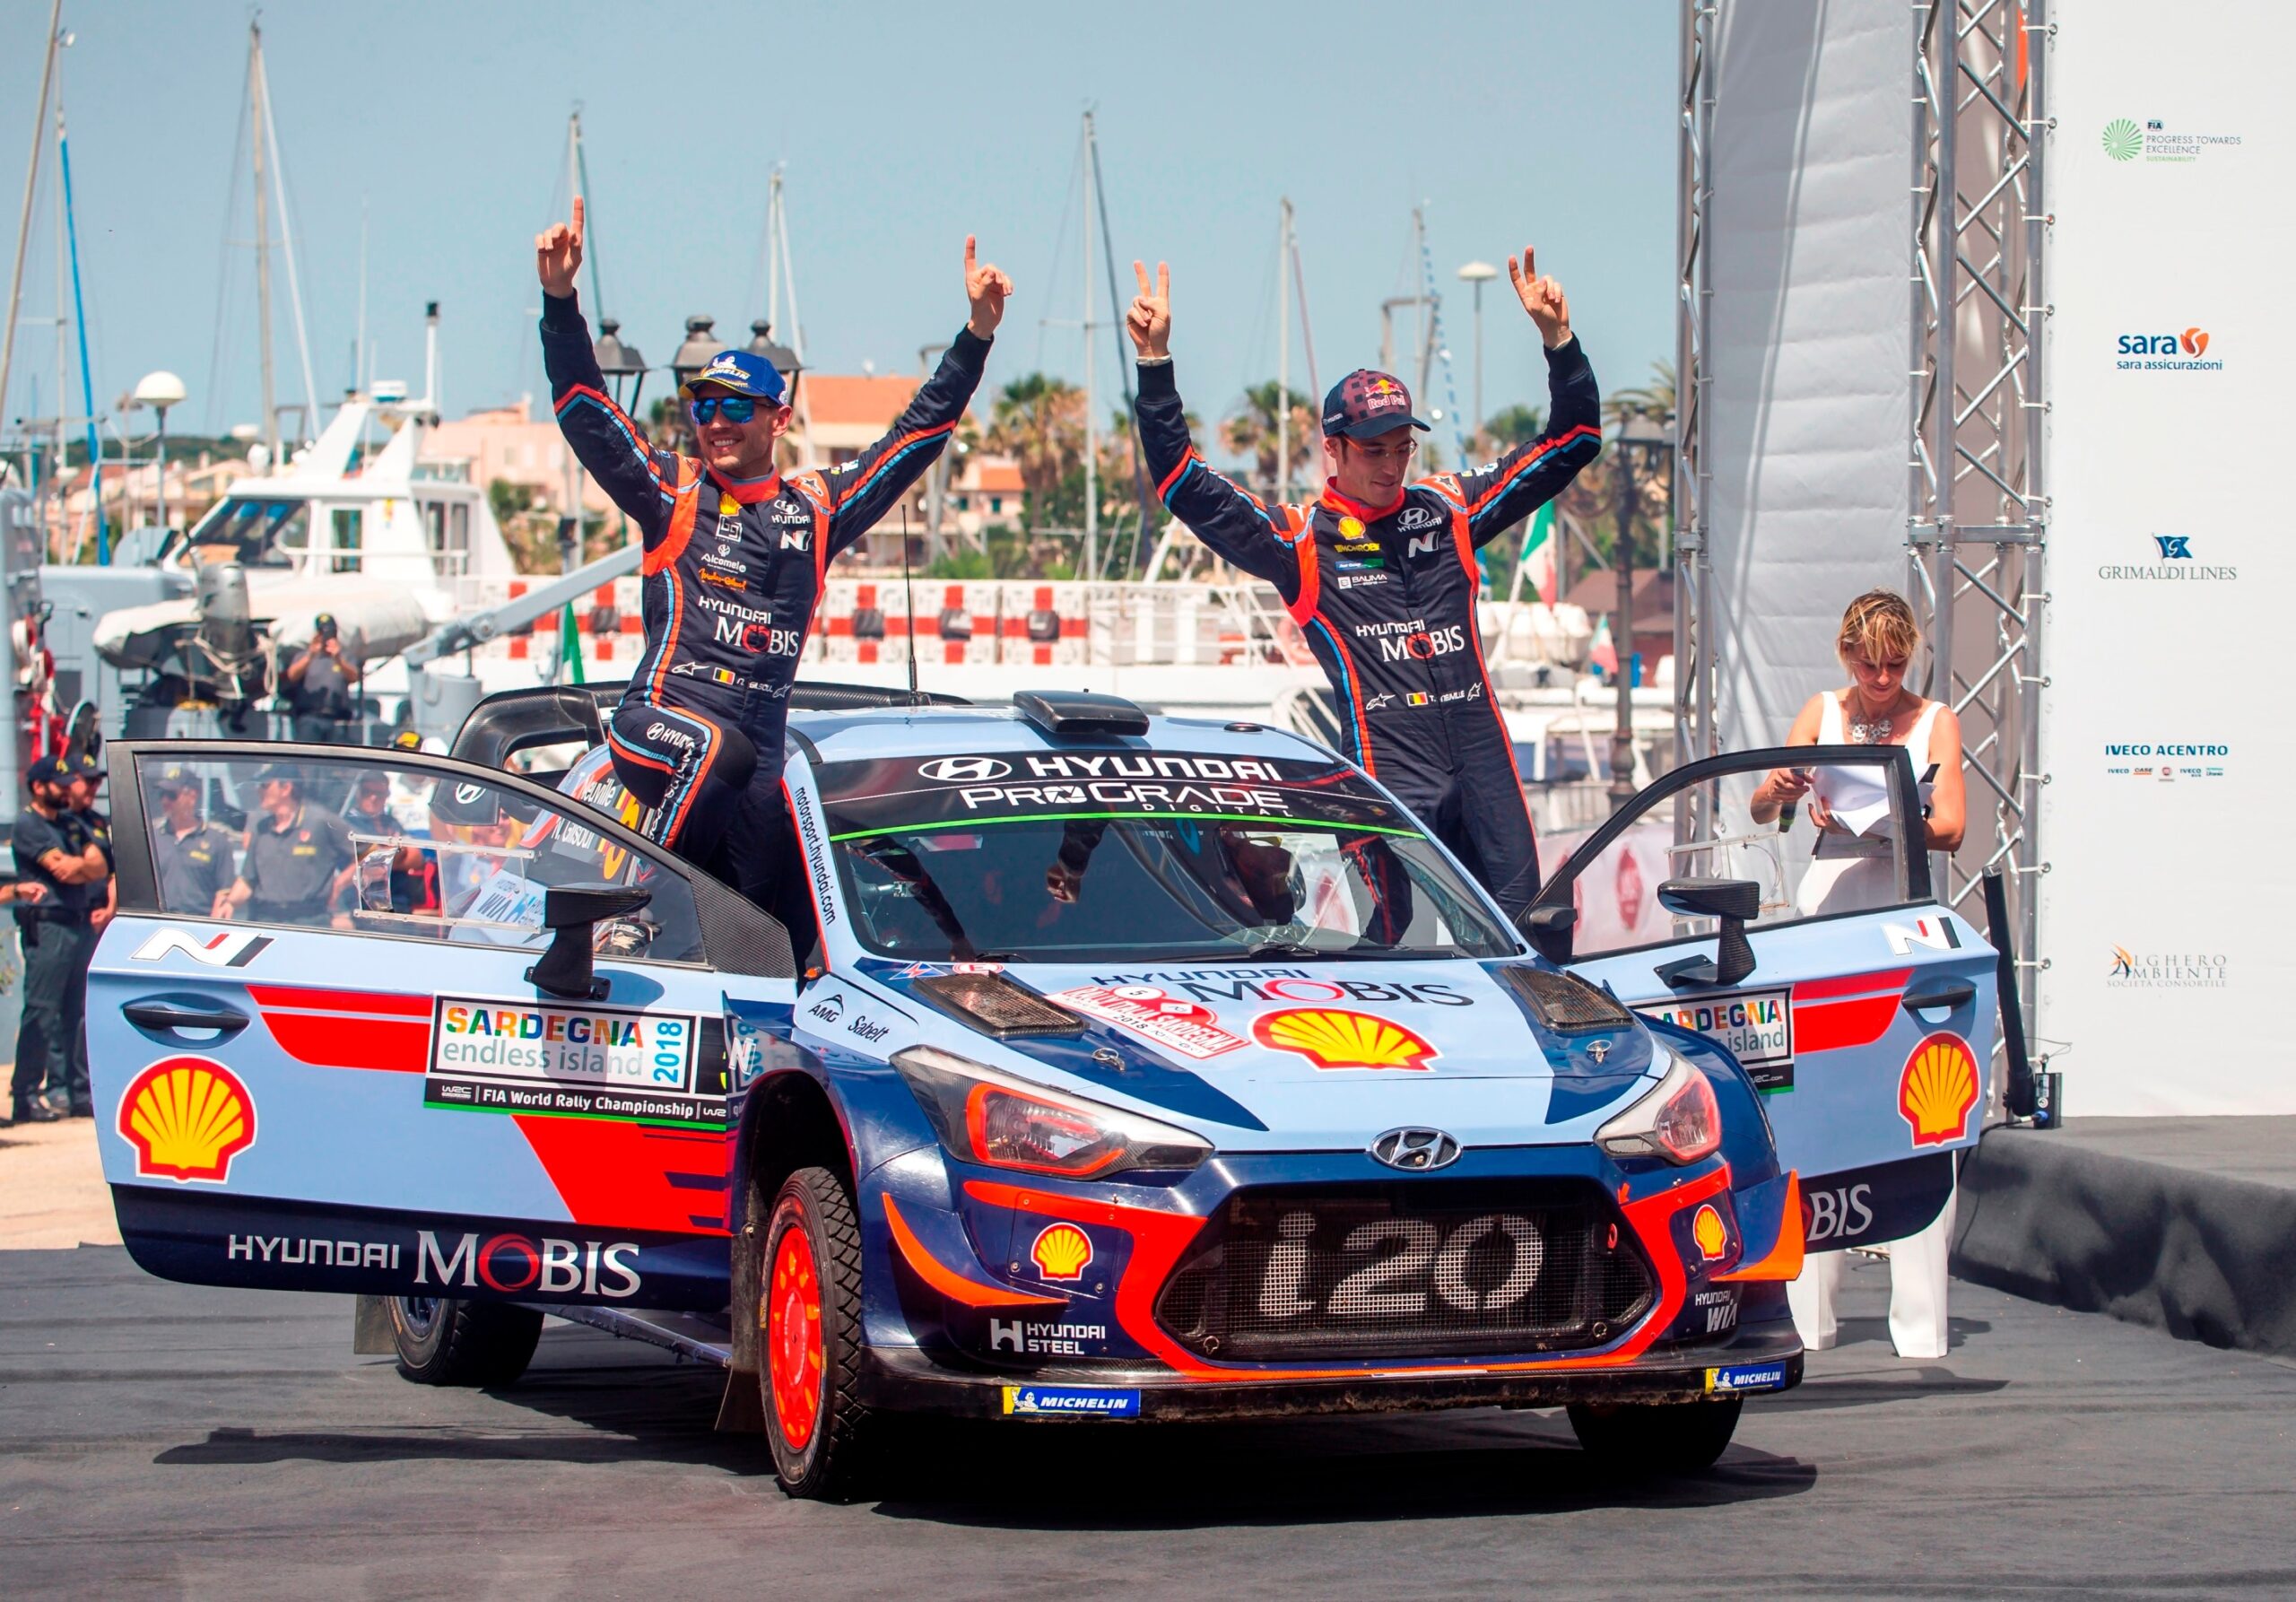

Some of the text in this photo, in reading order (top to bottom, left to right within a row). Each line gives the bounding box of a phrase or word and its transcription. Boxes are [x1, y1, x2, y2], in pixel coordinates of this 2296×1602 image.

[2146, 135, 2241, 145] PROGRESS TOWARDS
[2146, 145, 2201, 154] EXCELLENCE
[2118, 335, 2177, 354] sara
[2117, 359, 2222, 370] sara assicurazioni
[1397, 517, 1442, 533] HYUNDAI
[2099, 566, 2237, 580] GRIMALDI LINES
[698, 596, 771, 624] HYUNDAI
[714, 616, 799, 657] MOBIS
[1355, 619, 1425, 637] HYUNDAI
[1378, 625, 1465, 662] MOBIS
[2106, 745, 2228, 755] IVECO ACENTRO
[1032, 757, 1283, 781] HYUNDAI
[1144, 804, 1292, 817] DIGITAL
[795, 787, 836, 926] motorsport.hyundai.com
[1091, 970, 1312, 986] HYUNDAI
[1177, 979, 1474, 1006] MOBIS
[446, 1006, 644, 1049] SARDEGNA
[848, 1015, 890, 1042] Sabelt
[1114, 1014, 1149, 1030] 2018
[1728, 1024, 1784, 1053] island
[443, 1040, 644, 1076] endless island
[653, 1022, 683, 1083] 2018
[483, 1089, 694, 1119] FIA World Rally Championship
[1801, 1184, 1873, 1241] BIS
[228, 1230, 642, 1297] HYUNDAI MOBIS
[1695, 1290, 1732, 1307] HYUNDAI
[1026, 1323, 1106, 1339] HYUNDAI
[1028, 1340, 1085, 1355] STEEL
[1734, 1371, 1781, 1385] MICHELIN
[1040, 1397, 1129, 1409] MICHELIN
